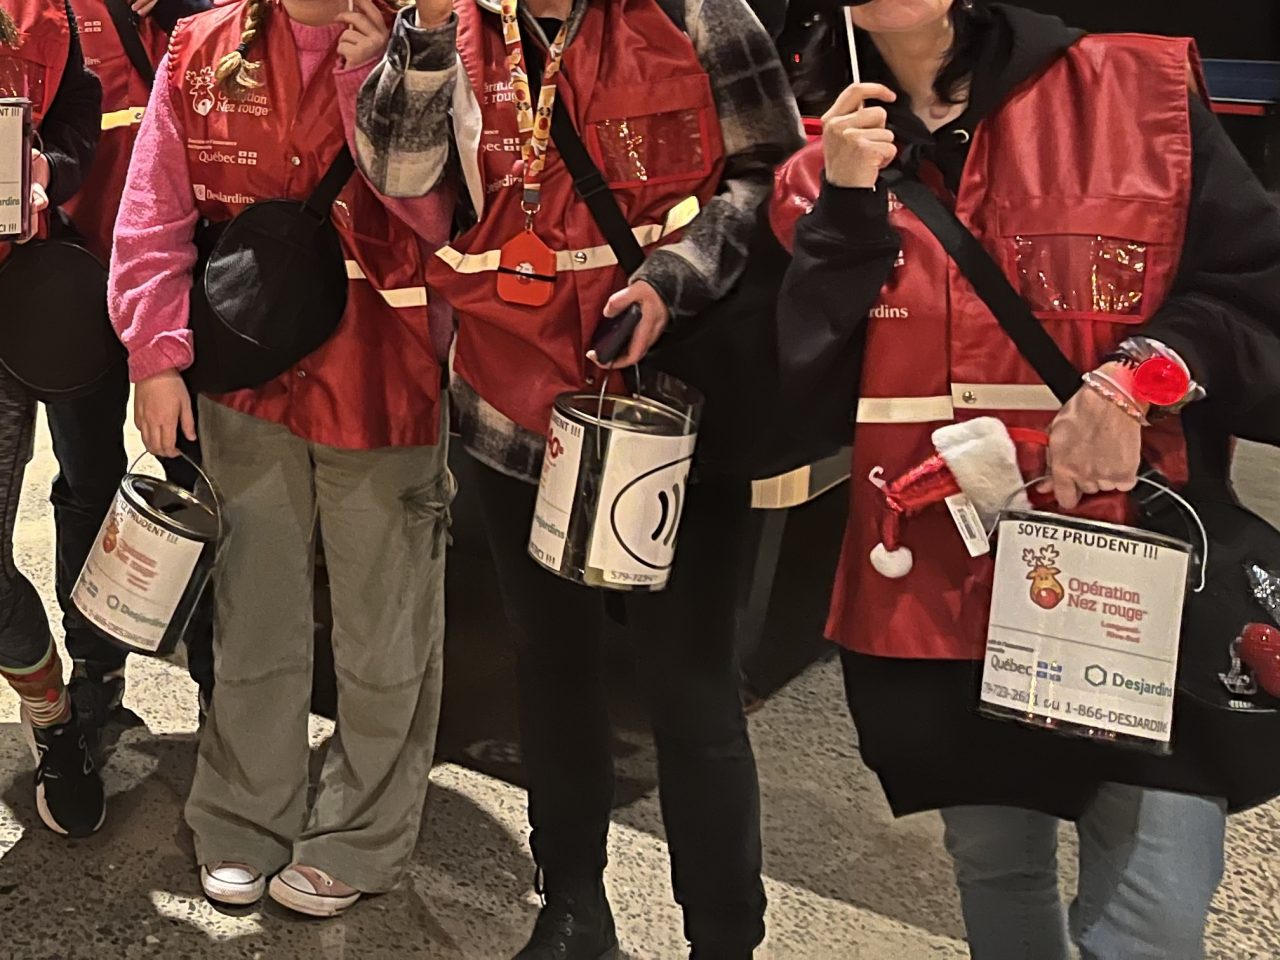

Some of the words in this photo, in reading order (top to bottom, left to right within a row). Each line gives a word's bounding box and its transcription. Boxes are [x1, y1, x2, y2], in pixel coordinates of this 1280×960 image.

[216, 100, 235, 112] Nez
[238, 104, 269, 116] rouge
[199, 151, 236, 163] Québec
[869, 305, 909, 318] rdins
[127, 508, 167, 537] PRUDENT
[1018, 523, 1059, 541] SOYEZ
[1062, 530, 1140, 555] PRUDENT
[1143, 544, 1159, 560] !!!
[1068, 577, 1140, 604] Opération
[1067, 593, 1097, 612] Nez
[1102, 603, 1144, 621] rouge
[991, 654, 1033, 676] Québec
[1043, 698, 1060, 710] ou
